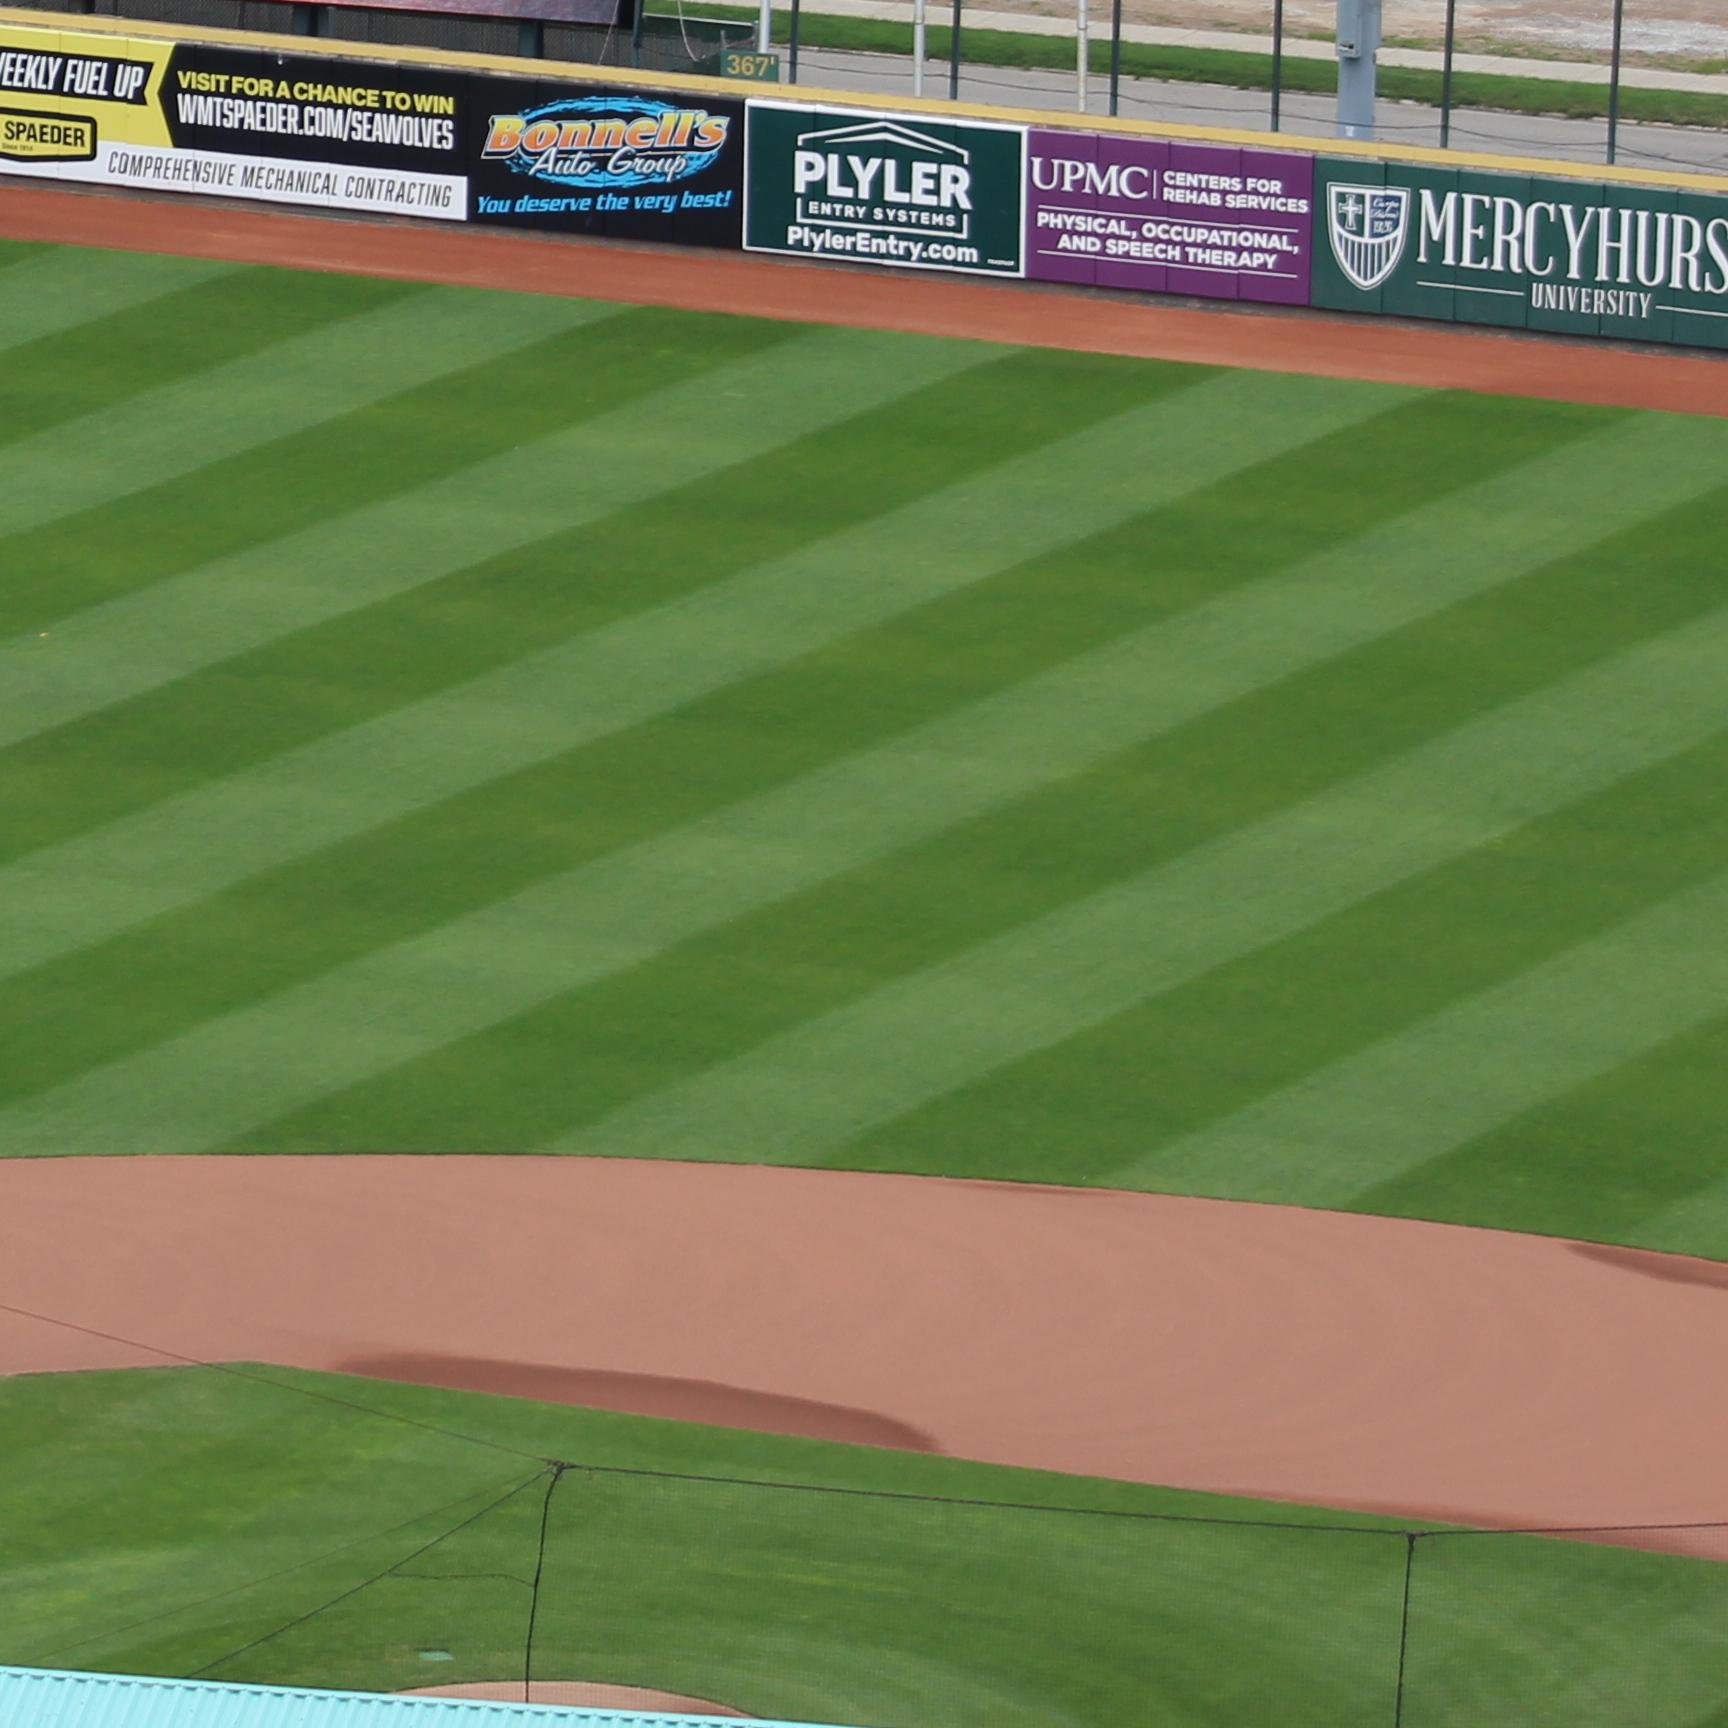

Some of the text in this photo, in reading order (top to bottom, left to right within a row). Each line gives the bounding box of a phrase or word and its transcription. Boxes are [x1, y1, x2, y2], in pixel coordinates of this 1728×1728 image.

[63, 58, 109, 97] FUEL
[113, 64, 146, 100] UP
[177, 71, 455, 115] VISIT FOR A CHANCE TO WIN
[4, 121, 85, 148] SPAEDER
[177, 93, 455, 150] WMTSPAEDER.COM/SEAWOLVES
[481, 109, 731, 159] Bonnell's
[108, 151, 452, 208] COMPREHENSIVE MECHANICAL CONTRACTING
[528, 146, 687, 182] Auto Group
[794, 150, 973, 210] PLYLER
[1030, 156, 1149, 200] UPMC
[1163, 170, 1282, 195] CENTERS FOR
[477, 190, 732, 214] You deserve the very best!
[808, 201, 956, 227] ENTRY SYSTEMS
[1163, 187, 1309, 214] REHAB SERVICES
[787, 225, 978, 263] PlylerEntry.com
[1036, 211, 1299, 255] PHYSICAL, OCCUPATIONAL,
[1057, 234, 1278, 270] AND SPEECH THERAPY
[1531, 281, 1652, 319] UNIVERSITY
